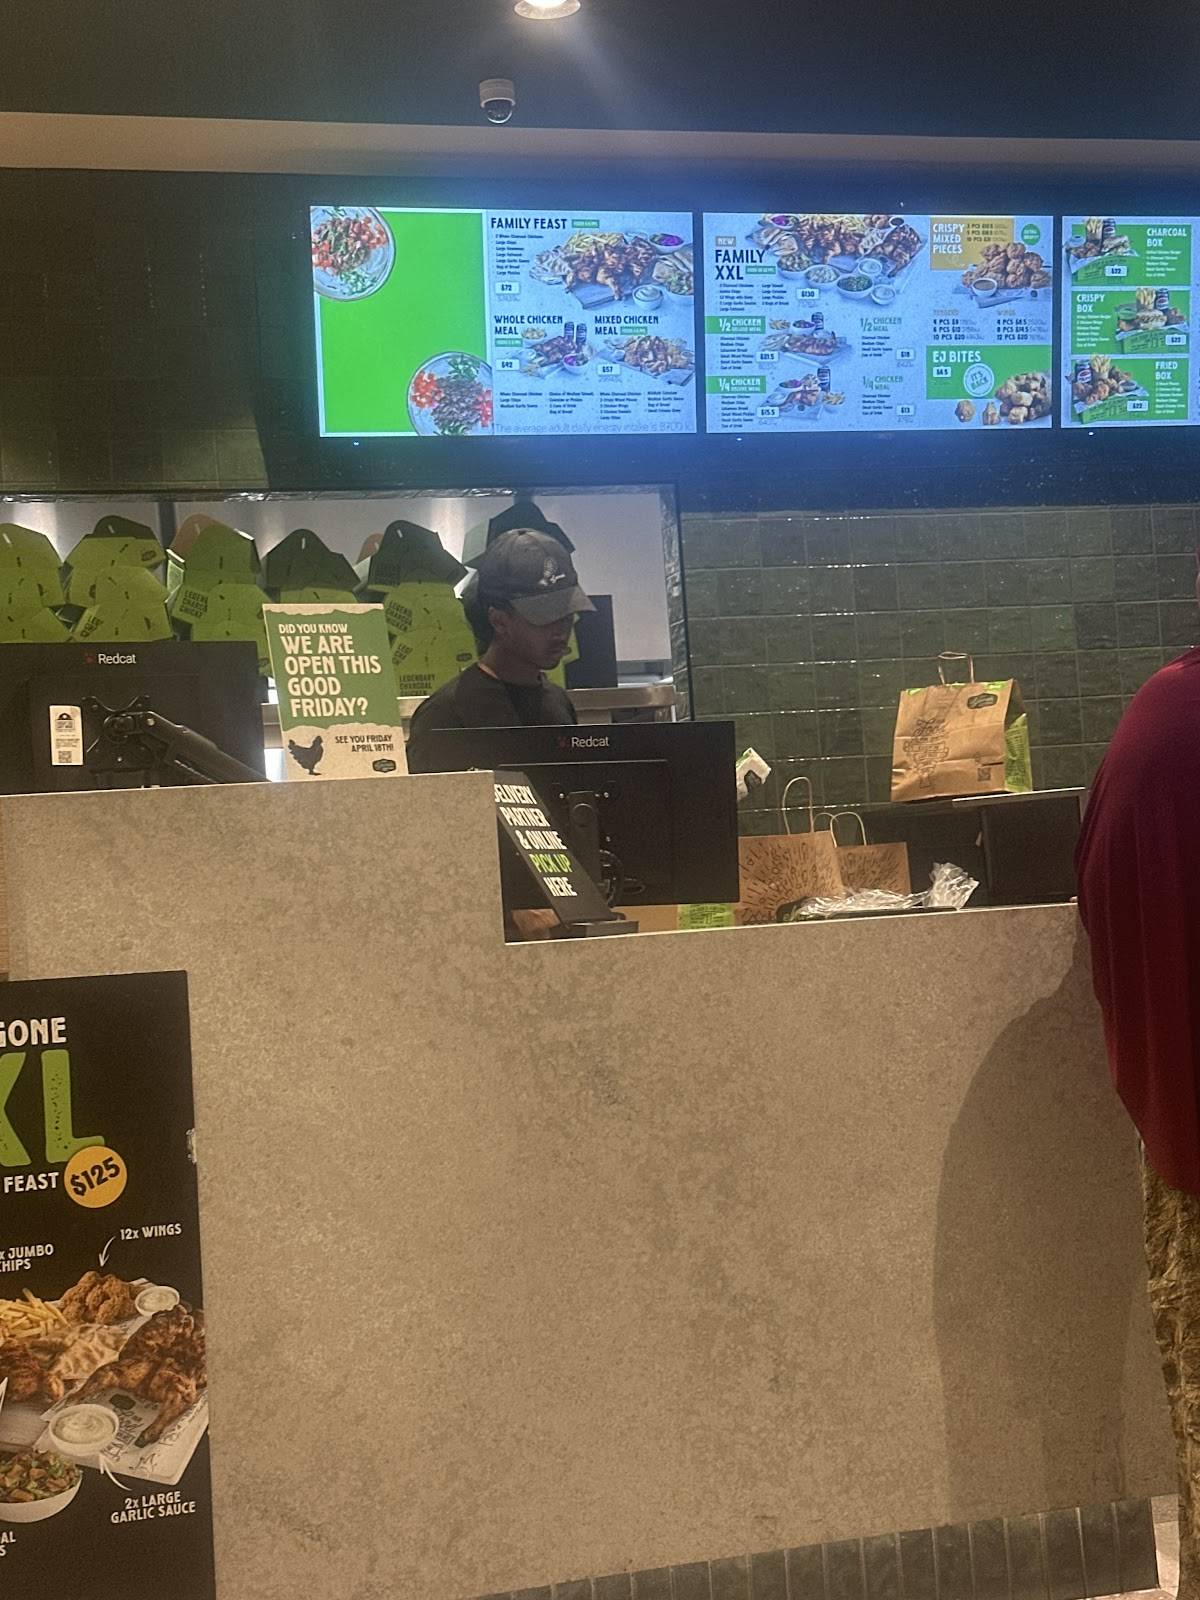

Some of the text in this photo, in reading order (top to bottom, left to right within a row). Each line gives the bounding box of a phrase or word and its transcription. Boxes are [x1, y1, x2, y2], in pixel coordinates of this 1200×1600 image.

[491, 218, 531, 229] FAMILY
[534, 218, 568, 229] FEAST
[933, 223, 965, 232] CRISPY
[1146, 228, 1187, 236] CHARCOAL
[933, 234, 961, 243] MIXED
[1146, 239, 1163, 247] BOX
[932, 244, 963, 254] PIECES
[715, 250, 765, 263] FAMILY
[715, 265, 744, 280] XXL
[1076, 294, 1105, 302] CRISPY
[1076, 304, 1093, 312] BOX
[494, 315, 563, 324] WHOLE CHICKEN
[595, 315, 659, 324] MIXED CHICKEN
[873, 317, 902, 325] CHICKEN
[494, 326, 519, 335] MEAL
[595, 326, 618, 335] MEAL
[932, 351, 981, 363] EJ BITES
[1155, 361, 1178, 369] FRIED
[1155, 372, 1171, 380] BOX
[731, 378, 760, 386] CHICKEN
[278, 623, 348, 634] DID YOU KNOW
[280, 635, 355, 654] WE ARE
[98, 653, 137, 664] Redcat
[285, 655, 382, 675] OPEN THIS
[288, 677, 341, 696] GOOD
[290, 697, 369, 718] FRIDAY?
[335, 734, 392, 744] SEE YOU FRIDAY
[571, 736, 609, 748] Redcat
[351, 744, 374, 752] APRIL
[500, 807, 550, 827] PARTNER
[515, 830, 567, 850] & ONLINE
[529, 854, 573, 873] PICK UP
[543, 877, 577, 897] HERE
[0, 1017, 67, 1048] ONE
[70, 1156, 121, 1197] $125
[3, 1172, 59, 1194] FEAST
[120, 1223, 182, 1241] 12x WINGS
[8, 1243, 54, 1260] JUMBO
[125, 1491, 181, 1510] 2x LARGE
[111, 1501, 196, 1524] GARLIC SAUCE
